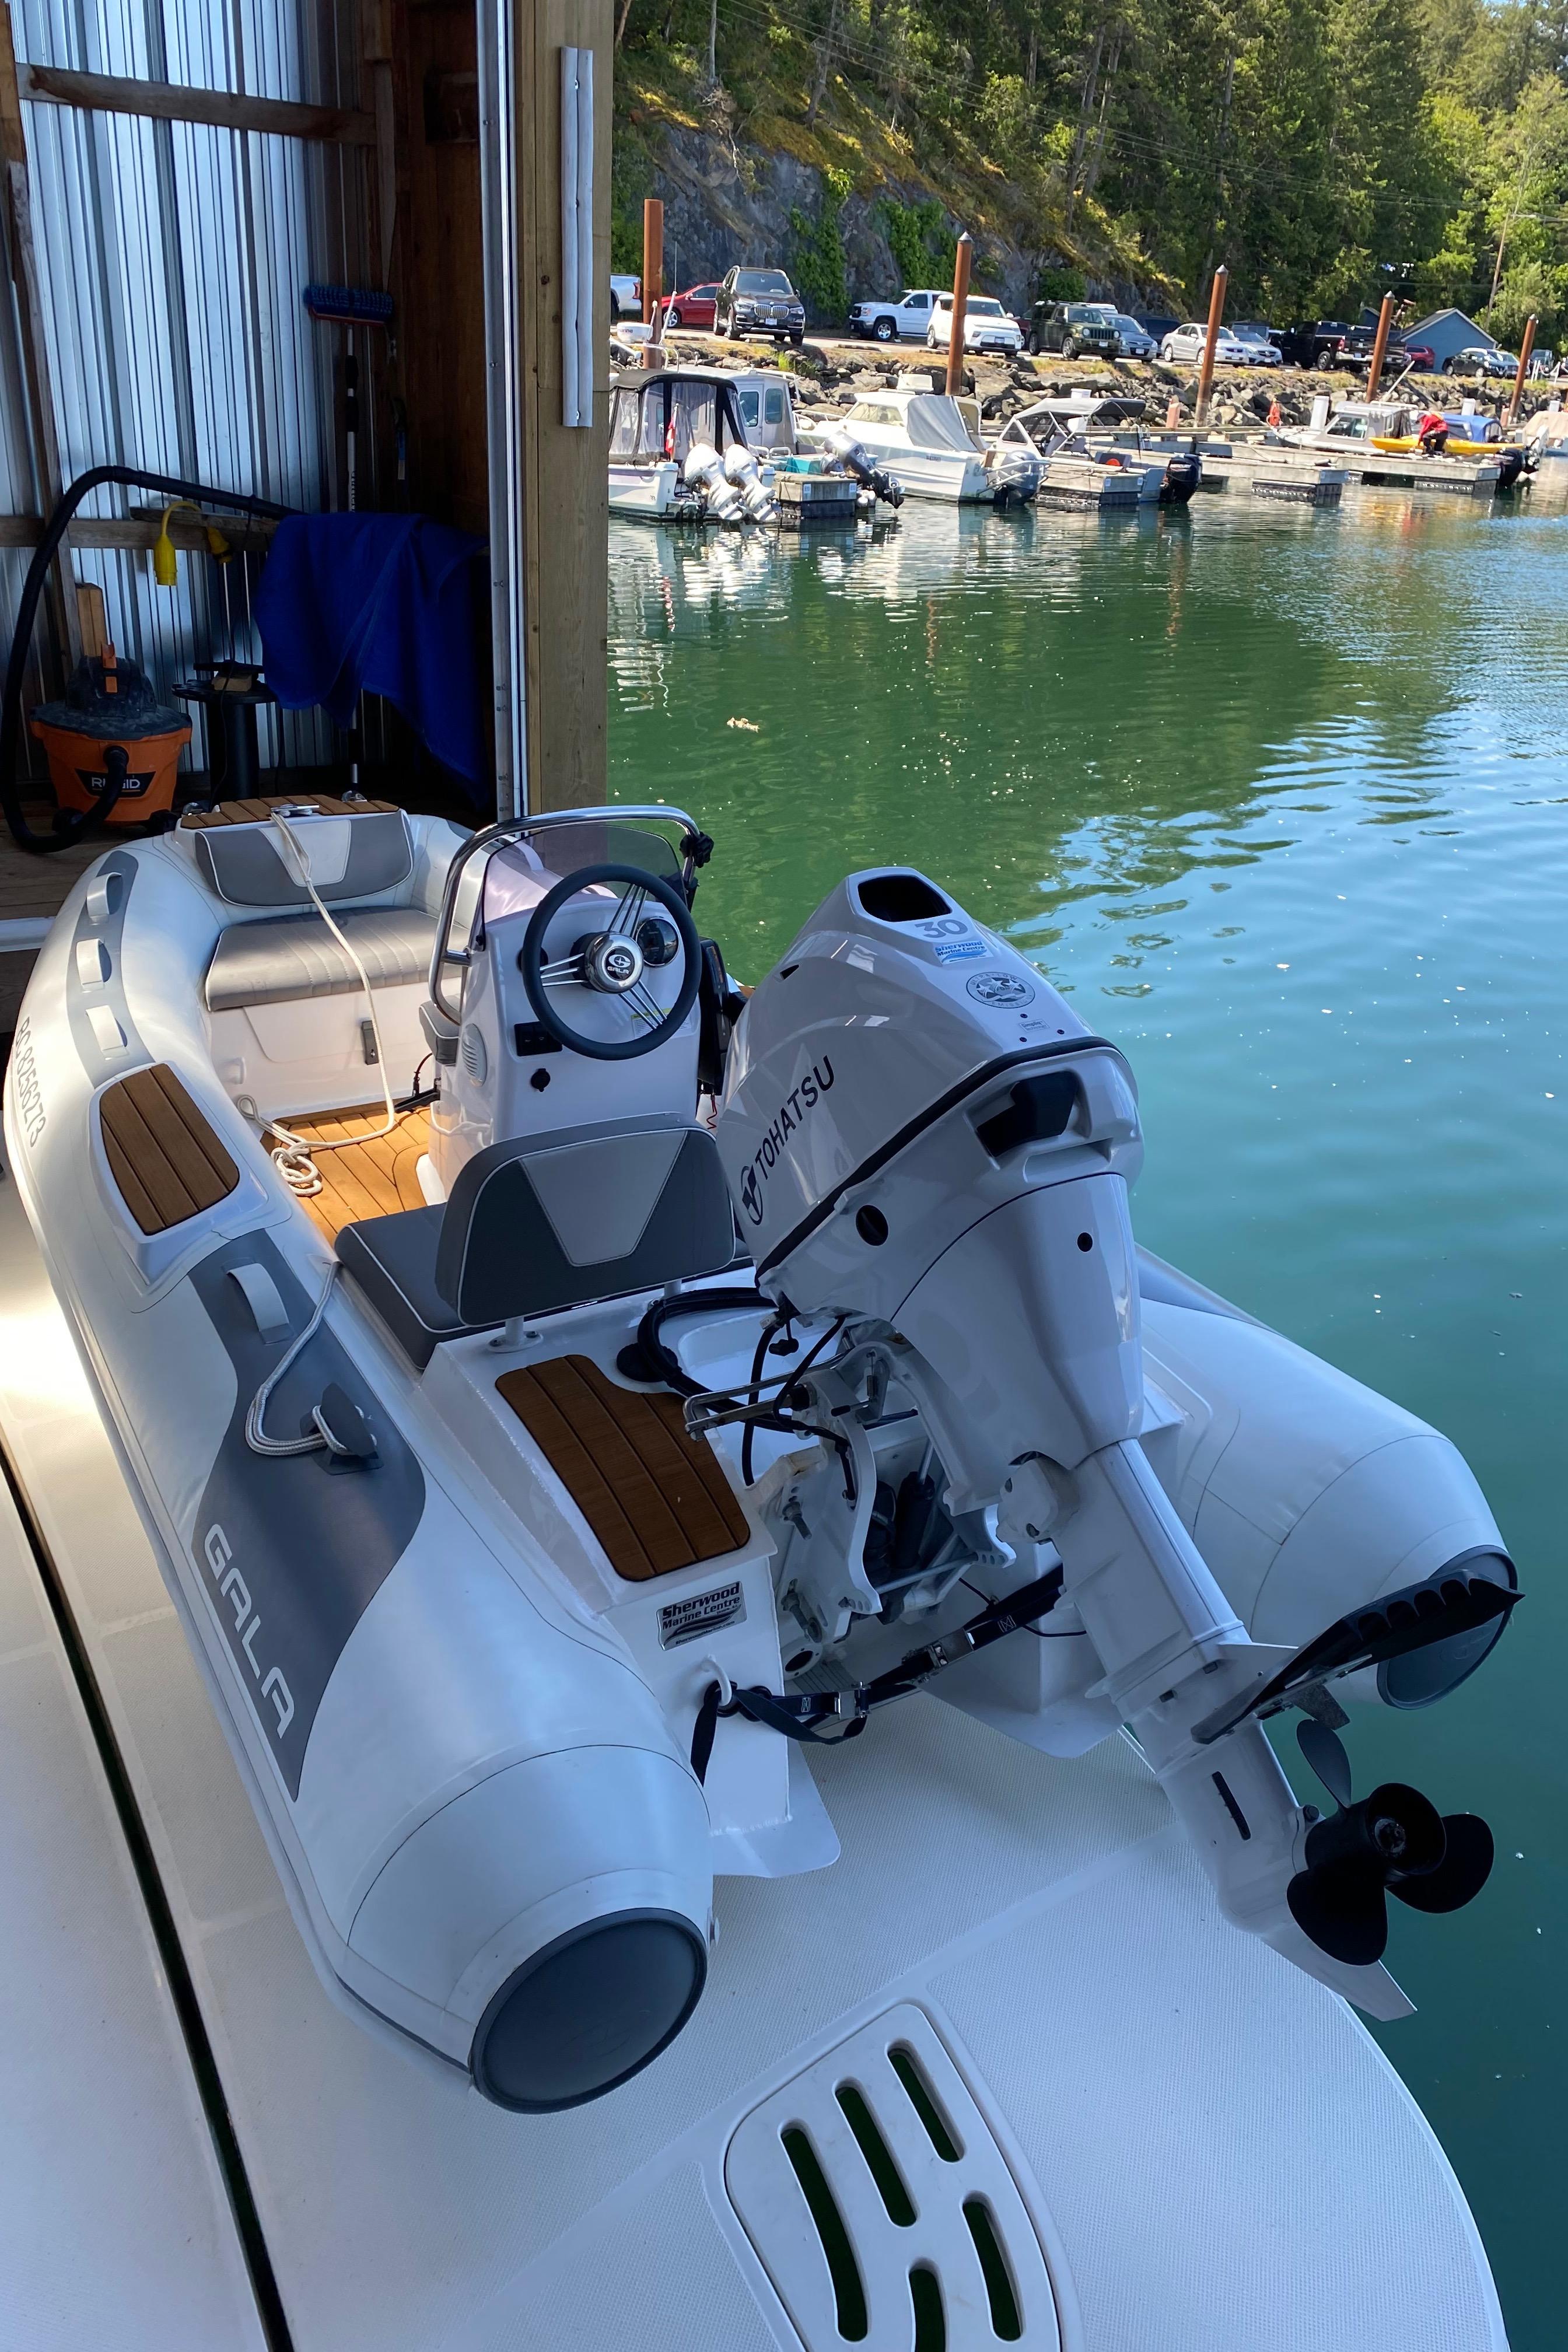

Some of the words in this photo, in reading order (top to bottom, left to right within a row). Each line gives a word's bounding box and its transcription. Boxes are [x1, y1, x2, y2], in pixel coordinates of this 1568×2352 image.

[92, 777, 140, 789] RIID
[914, 919, 968, 938] 30
[935, 941, 983, 953] Sherwood
[937, 949, 962, 957] Marine
[607, 966, 629, 974] GALA
[16, 1017, 31, 1059] BC
[17, 1046, 47, 1147] 8256273
[755, 1055, 835, 1180] TOHATSU
[662, 1583, 740, 1620] Sherwood
[663, 1612, 702, 1630] Marine
[704, 1597, 740, 1615] Centre
[204, 1523, 295, 1740] GALA
